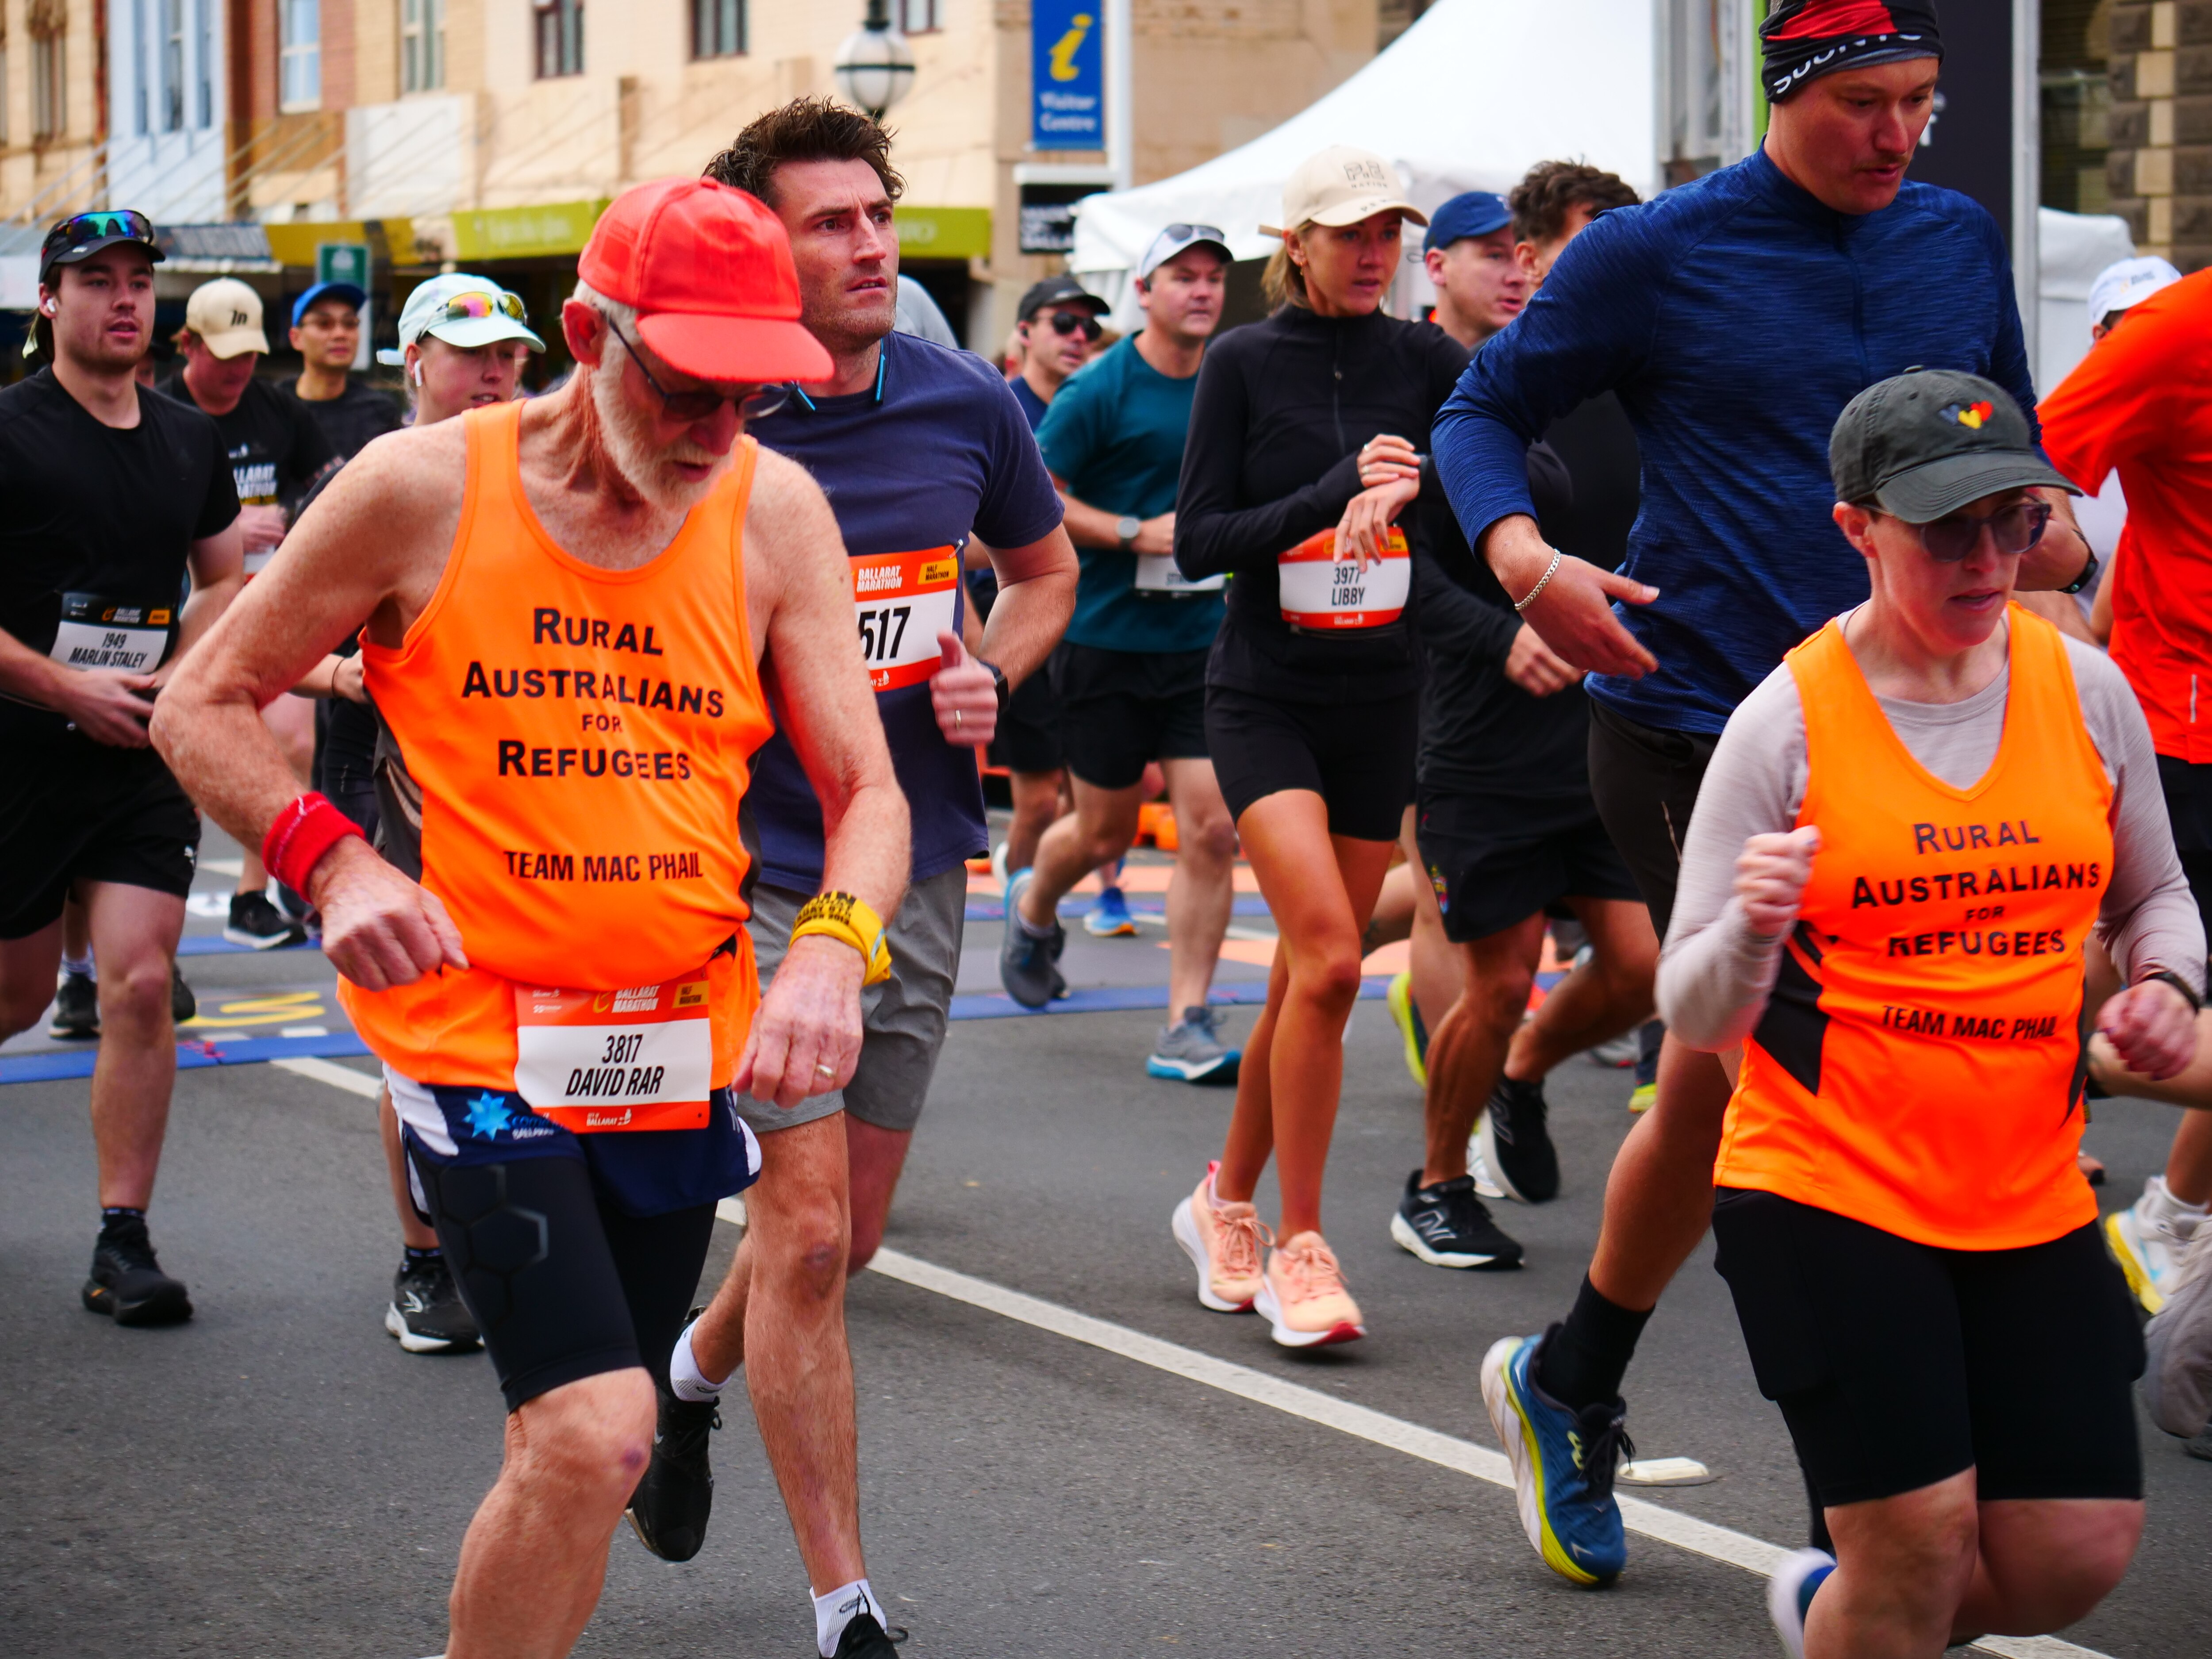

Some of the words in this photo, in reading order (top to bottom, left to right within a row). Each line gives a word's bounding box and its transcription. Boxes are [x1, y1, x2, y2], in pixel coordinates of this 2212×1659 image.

[858, 565, 901, 580] BALLARAT
[926, 570, 949, 581] MARATHON
[1334, 567, 1361, 584] 3977
[856, 577, 902, 592] MARATHON
[1332, 587, 1365, 606] LIBBY
[102, 632, 127, 649] 1949
[534, 608, 663, 656] RURAL
[68, 648, 111, 666] MARLIN
[110, 651, 148, 668] STALEY
[462, 661, 724, 718] AUSTRALIANS
[582, 714, 621, 732] FOR
[499, 740, 691, 780] REFUGEES
[1914, 820, 2040, 854] RURAL
[504, 851, 573, 881] TEAM
[584, 854, 640, 881] MAC
[649, 852, 703, 879] PHAIL
[1852, 863, 2100, 909] AUSTRALIANS
[1966, 906, 2004, 922] FOR
[1889, 929, 2065, 956] REFUGEES
[615, 985, 660, 999] BALLARAT
[612, 998, 659, 1014] MARATHON
[1882, 1006, 1944, 1036] TEAM
[1953, 1018, 2005, 1038] MAC
[602, 1034, 643, 1063] 3817
[565, 1068, 625, 1097] DAVID
[625, 1066, 664, 1095] RAR
[586, 1116, 617, 1126] BALLARAT
